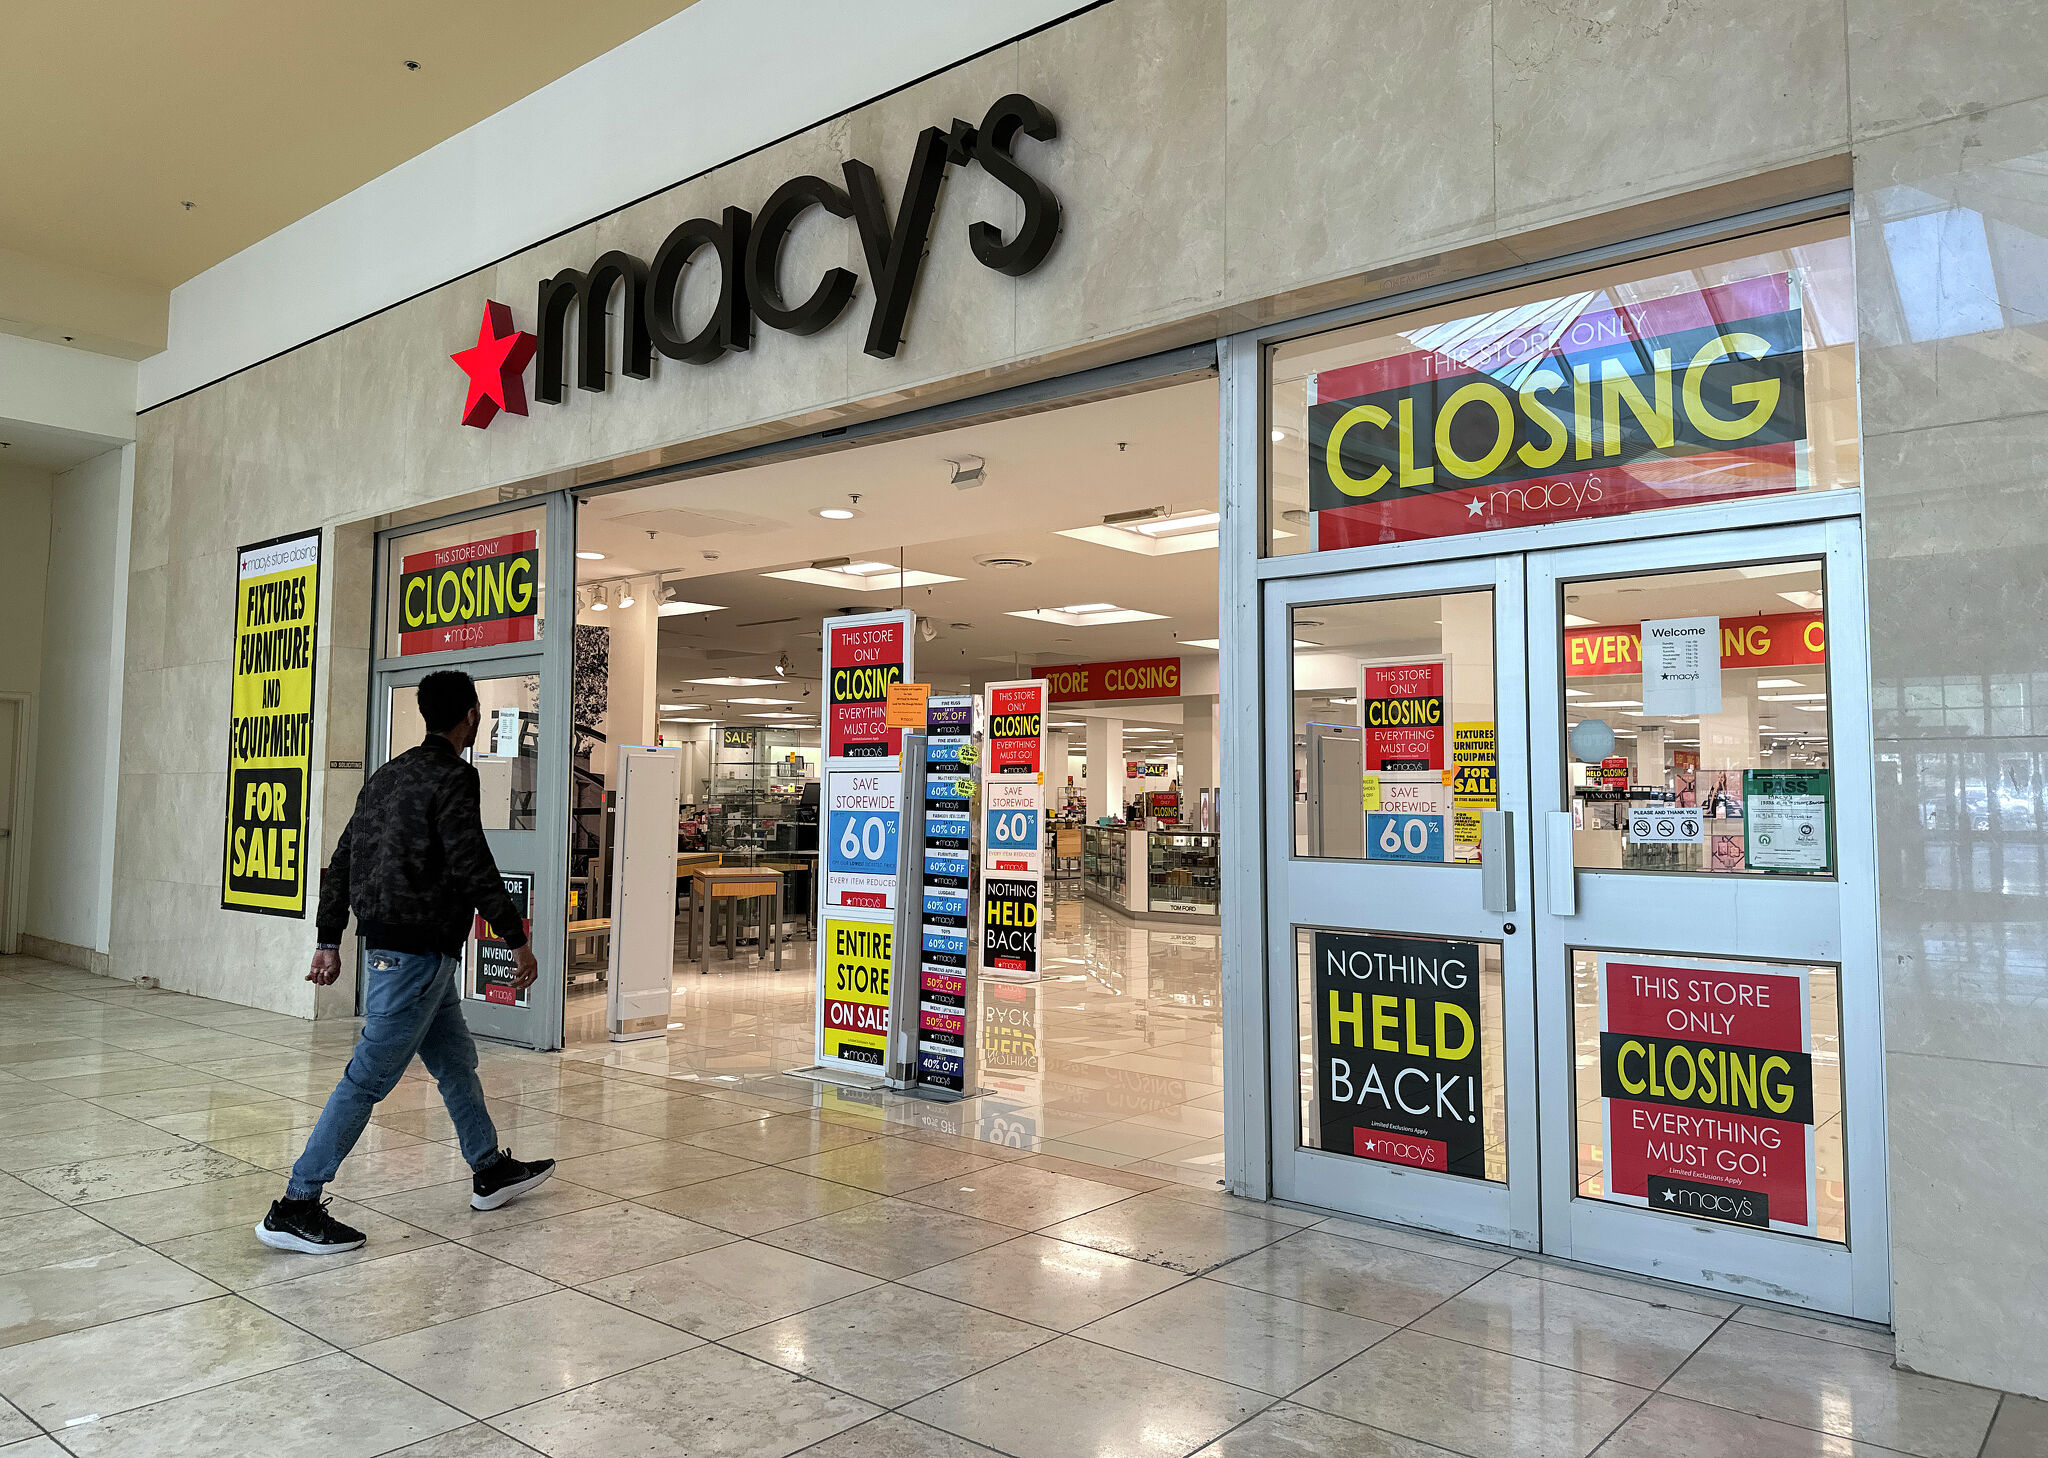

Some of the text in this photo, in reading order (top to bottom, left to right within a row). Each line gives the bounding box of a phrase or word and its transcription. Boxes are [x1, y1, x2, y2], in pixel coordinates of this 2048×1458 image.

[535, 93, 1062, 404] macy's
[1422, 310, 1647, 377] THIS STORE ONLY
[1326, 332, 1781, 497] CLOSING
[1490, 472, 1603, 516] macy's
[272, 550, 290, 566] store
[290, 545, 317, 562] closing
[435, 541, 500, 565] THIS STORE ONLY
[404, 557, 533, 628] CLOSING
[246, 576, 306, 627] FIXTURES
[450, 624, 484, 643] macy's
[842, 629, 894, 646] THIS STORE
[1652, 627, 1706, 638] Welcome
[239, 625, 310, 675] FURNITURE
[854, 648, 880, 661] ONLY
[1045, 665, 1178, 694] STORE CLOSING
[1376, 669, 1431, 681] THIS STORE
[1669, 671, 1700, 681] macy's
[262, 678, 281, 709] AND
[999, 690, 1035, 701] THIS STORE
[1389, 683, 1418, 695] ONLY
[839, 706, 886, 720] EVERYTHIN
[1007, 702, 1027, 712] ONLY
[1369, 699, 1440, 726] CLOSING
[932, 711, 967, 720] 70% OFF
[844, 722, 867, 735] MUST
[993, 714, 1040, 737] CLOSING
[233, 713, 309, 763] EQUIPMENT
[1374, 730, 1435, 741] EVERYTHING
[1456, 730, 1494, 739] FIXTURES
[996, 740, 1036, 750] EVERYTHING
[1380, 743, 1429, 753] MUST GO!
[1454, 741, 1494, 750] URNITURE
[931, 749, 948, 758] 60%
[1000, 750, 1033, 759] MUST GO!
[1454, 752, 1495, 762] EQUIPMEN
[1464, 767, 1490, 778] FOR
[1602, 768, 1627, 777] CLOSING
[852, 777, 879, 790] SAVE
[1004, 786, 1022, 796] SAVE
[1454, 778, 1496, 793] SALE
[1762, 780, 1808, 793] PASS
[931, 787, 948, 796] 60%
[1391, 787, 1419, 798] SAVE
[244, 782, 287, 822] FOR
[836, 795, 895, 809] STOREWIDE
[992, 798, 1034, 808] STOREWIDE
[1375, 801, 1437, 813] TOREWIDE
[1153, 807, 1178, 817] CLOSING
[931, 825, 966, 834] 60% OFF
[1380, 818, 1439, 854] 60%
[232, 826, 297, 881] SALE
[930, 862, 965, 873] 60% OFF
[503, 880, 523, 894] TORE
[830, 876, 848, 884] EVERY
[850, 877, 864, 885] ITEM
[987, 883, 1036, 898] NOTHING
[927, 901, 962, 912] 60% OFF
[987, 900, 1037, 927] HELD
[836, 929, 891, 960] ENTIRE
[928, 939, 964, 951] 60% OFF
[986, 929, 1037, 953] BACK!
[482, 946, 514, 962] INVENTO
[1327, 949, 1468, 989] NOTHING
[837, 963, 889, 996] STORE
[926, 977, 962, 991] 50% OFF
[1631, 975, 1770, 1008] THIS STORE
[830, 1002, 889, 1031] ON SALE
[925, 1016, 961, 1031] 50% OFF
[1667, 1008, 1735, 1035] ONLY
[1329, 989, 1475, 1061] HELD
[923, 1058, 959, 1072] 40% OFF
[1617, 1040, 1795, 1114] CLOSING
[1331, 1057, 1476, 1124] BACK!
[1371, 1120, 1429, 1136] Limited Exclusions Apply
[1632, 1109, 1782, 1149] EVERYTHING
[1377, 1139, 1435, 1165] macy's
[1646, 1140, 1768, 1178] MUST GO!
[1669, 1167, 1743, 1186] Limited Exclusions Apply
[1679, 1189, 1753, 1219] macy's
